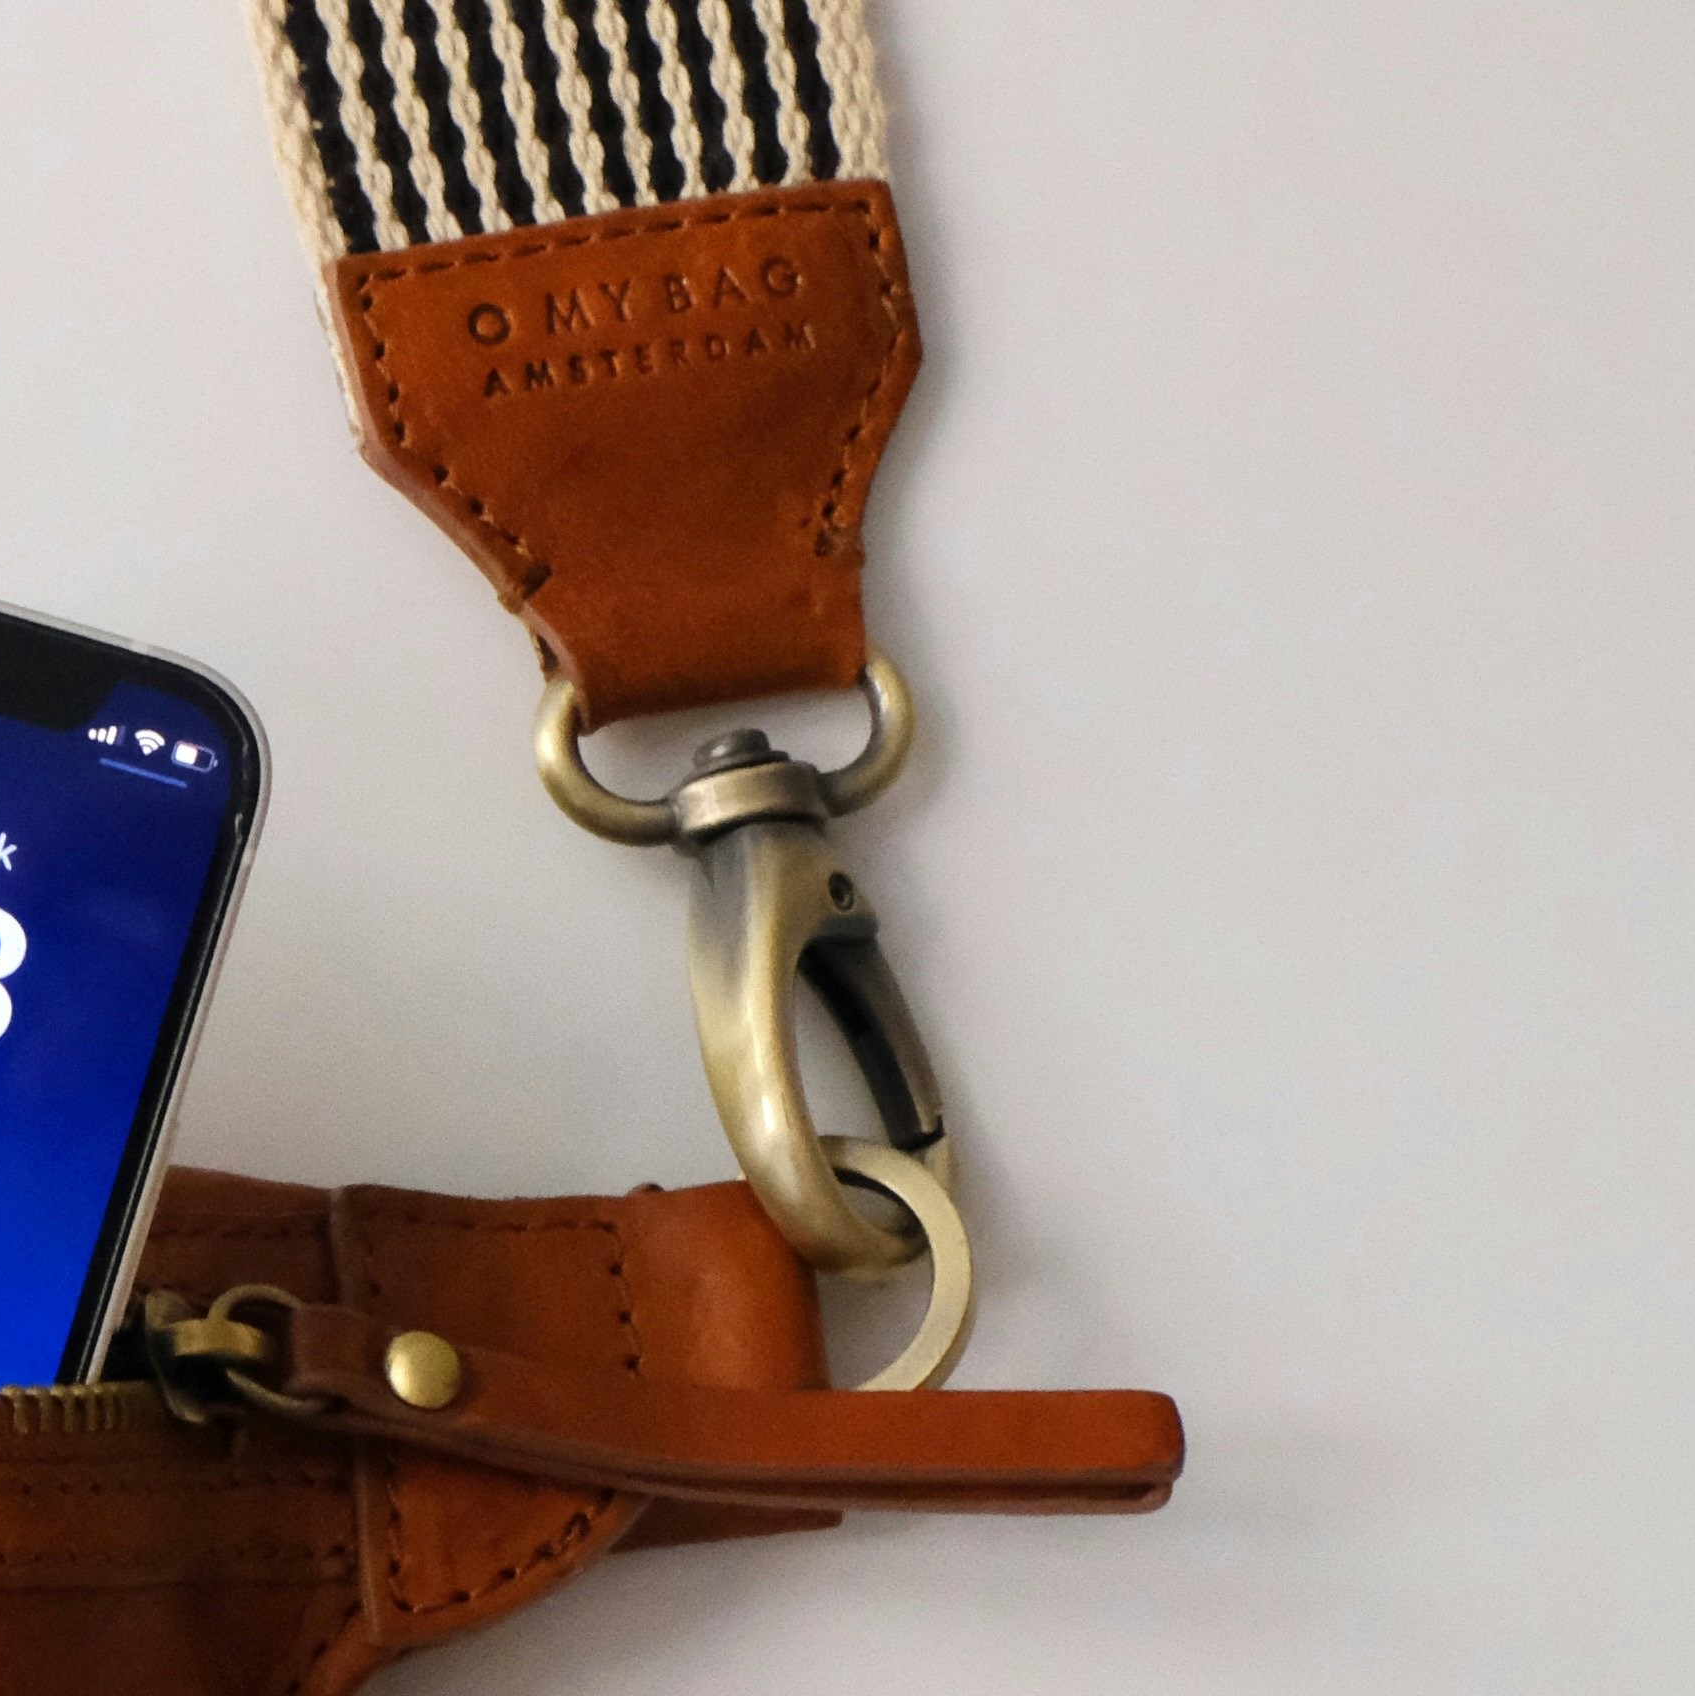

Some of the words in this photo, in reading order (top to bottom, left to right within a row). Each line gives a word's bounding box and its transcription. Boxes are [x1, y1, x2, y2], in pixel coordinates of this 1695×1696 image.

[466, 302, 513, 346] O
[545, 279, 636, 335] MY
[662, 255, 804, 315] BAG
[483, 321, 817, 399] AMSTERDAM
